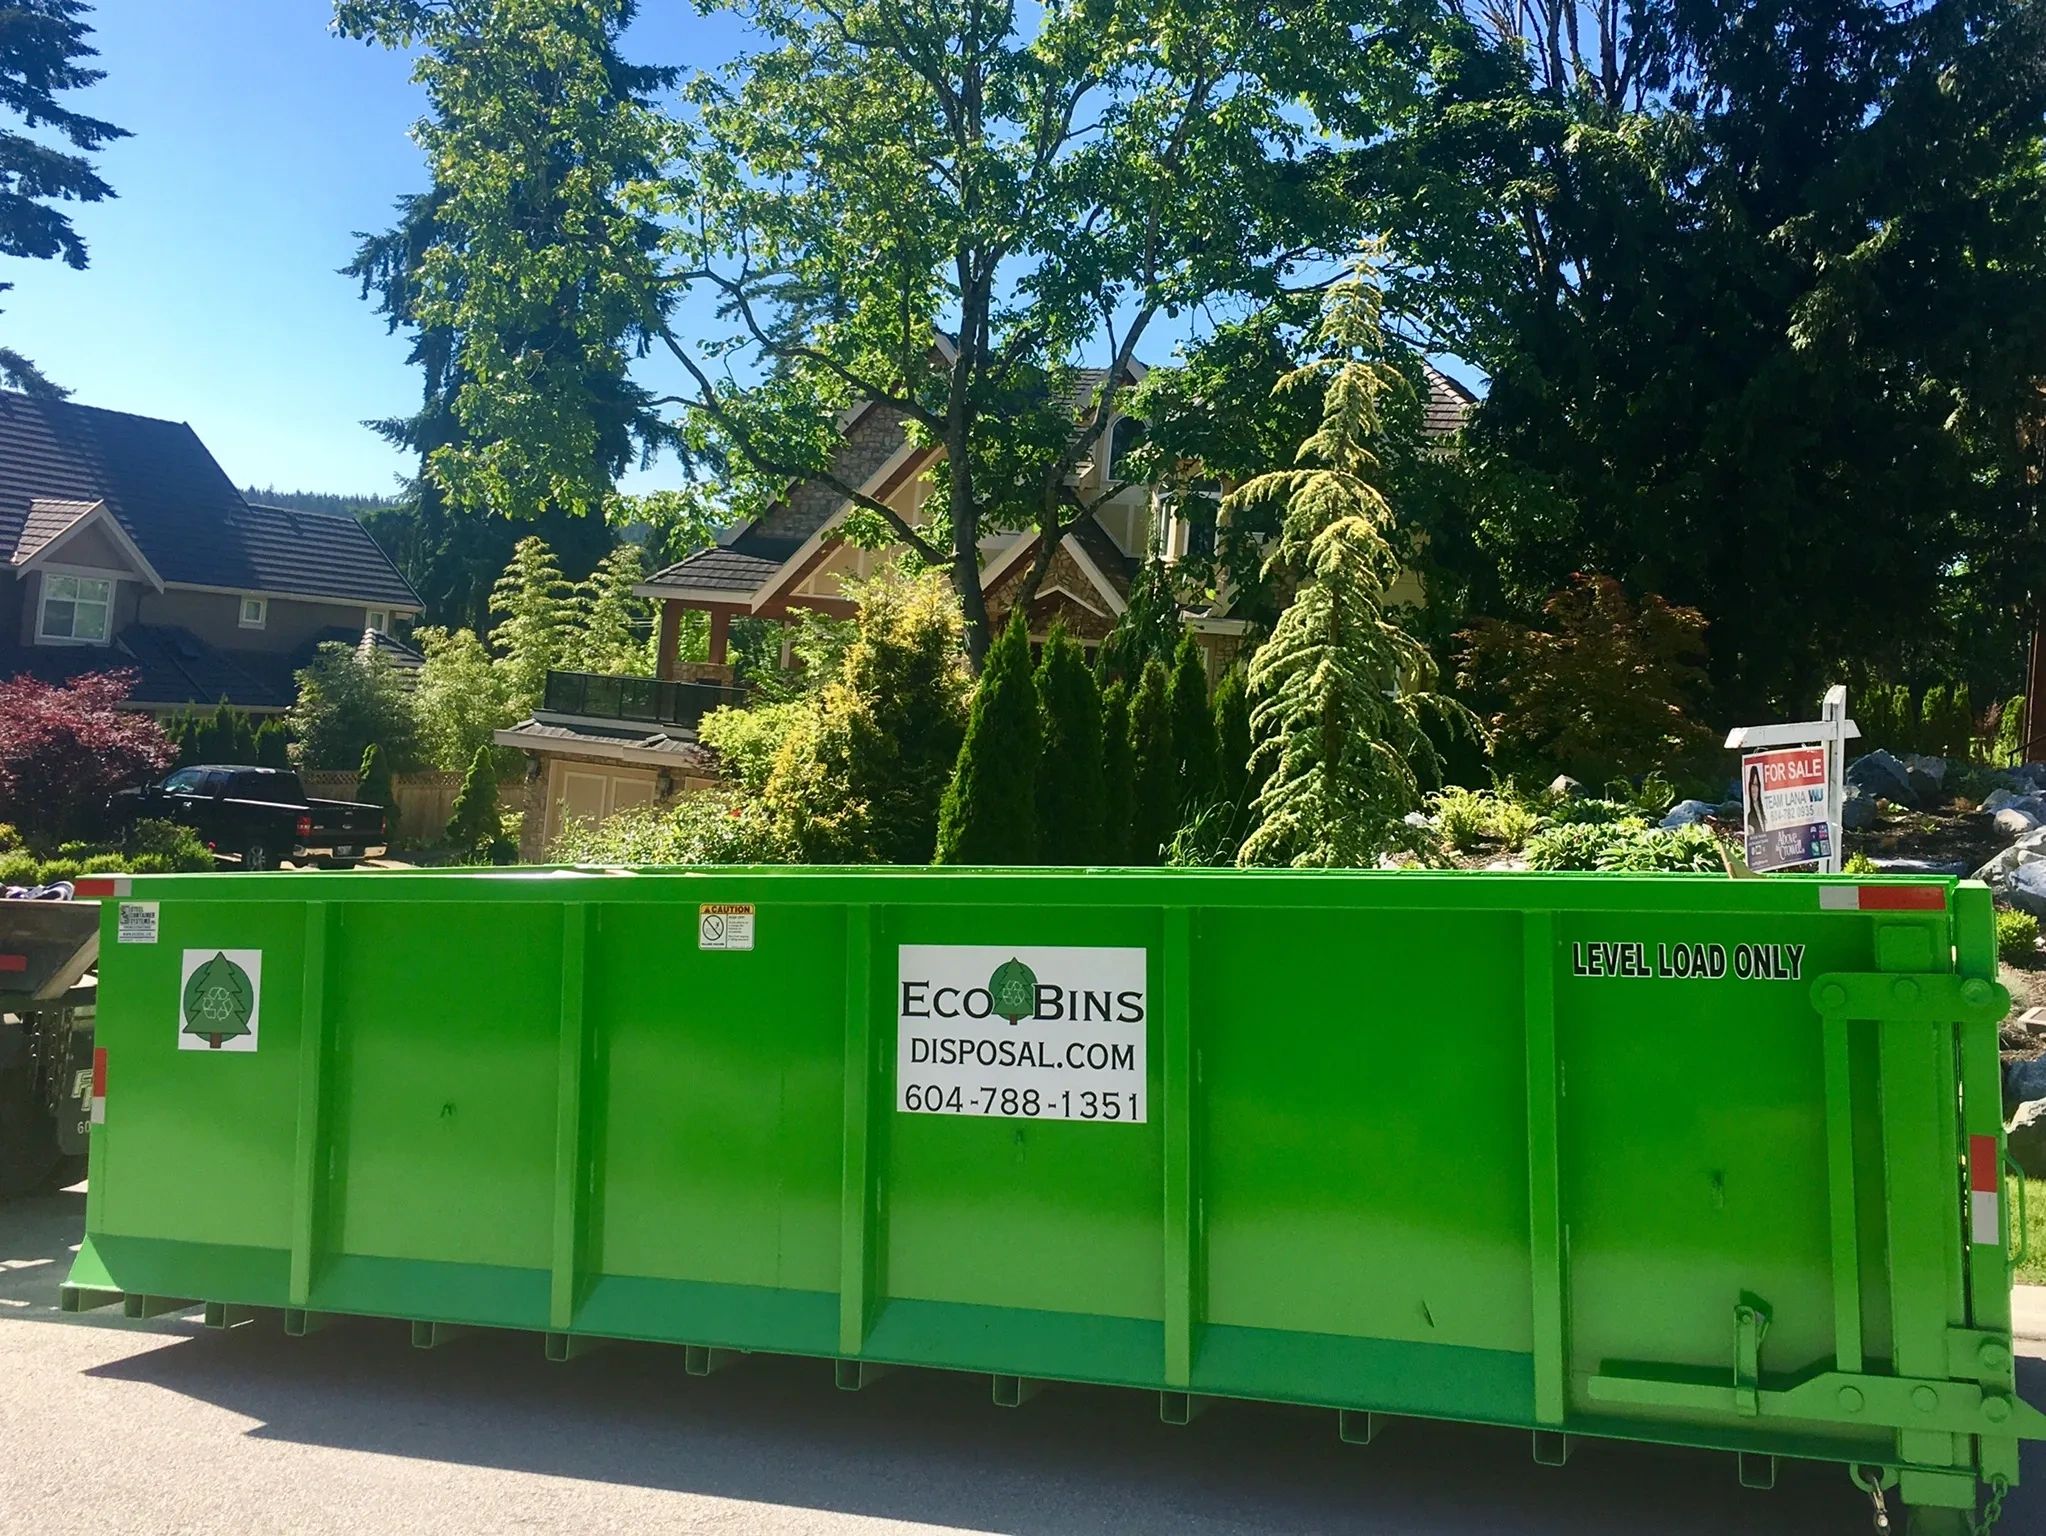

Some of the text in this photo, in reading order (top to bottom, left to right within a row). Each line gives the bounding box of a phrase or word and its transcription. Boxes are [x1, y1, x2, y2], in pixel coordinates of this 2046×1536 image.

[1764, 758, 1822, 783] FOR SALE
[1764, 794, 1784, 809] TEAM
[1785, 791, 1807, 806] LANA
[711, 906, 750, 914] CAUTION
[1572, 942, 1806, 980] LEVEL LOAD ONLY
[911, 1037, 1135, 1071] DISPOSAL.COM
[905, 1084, 1137, 1120] 604-788-1351
